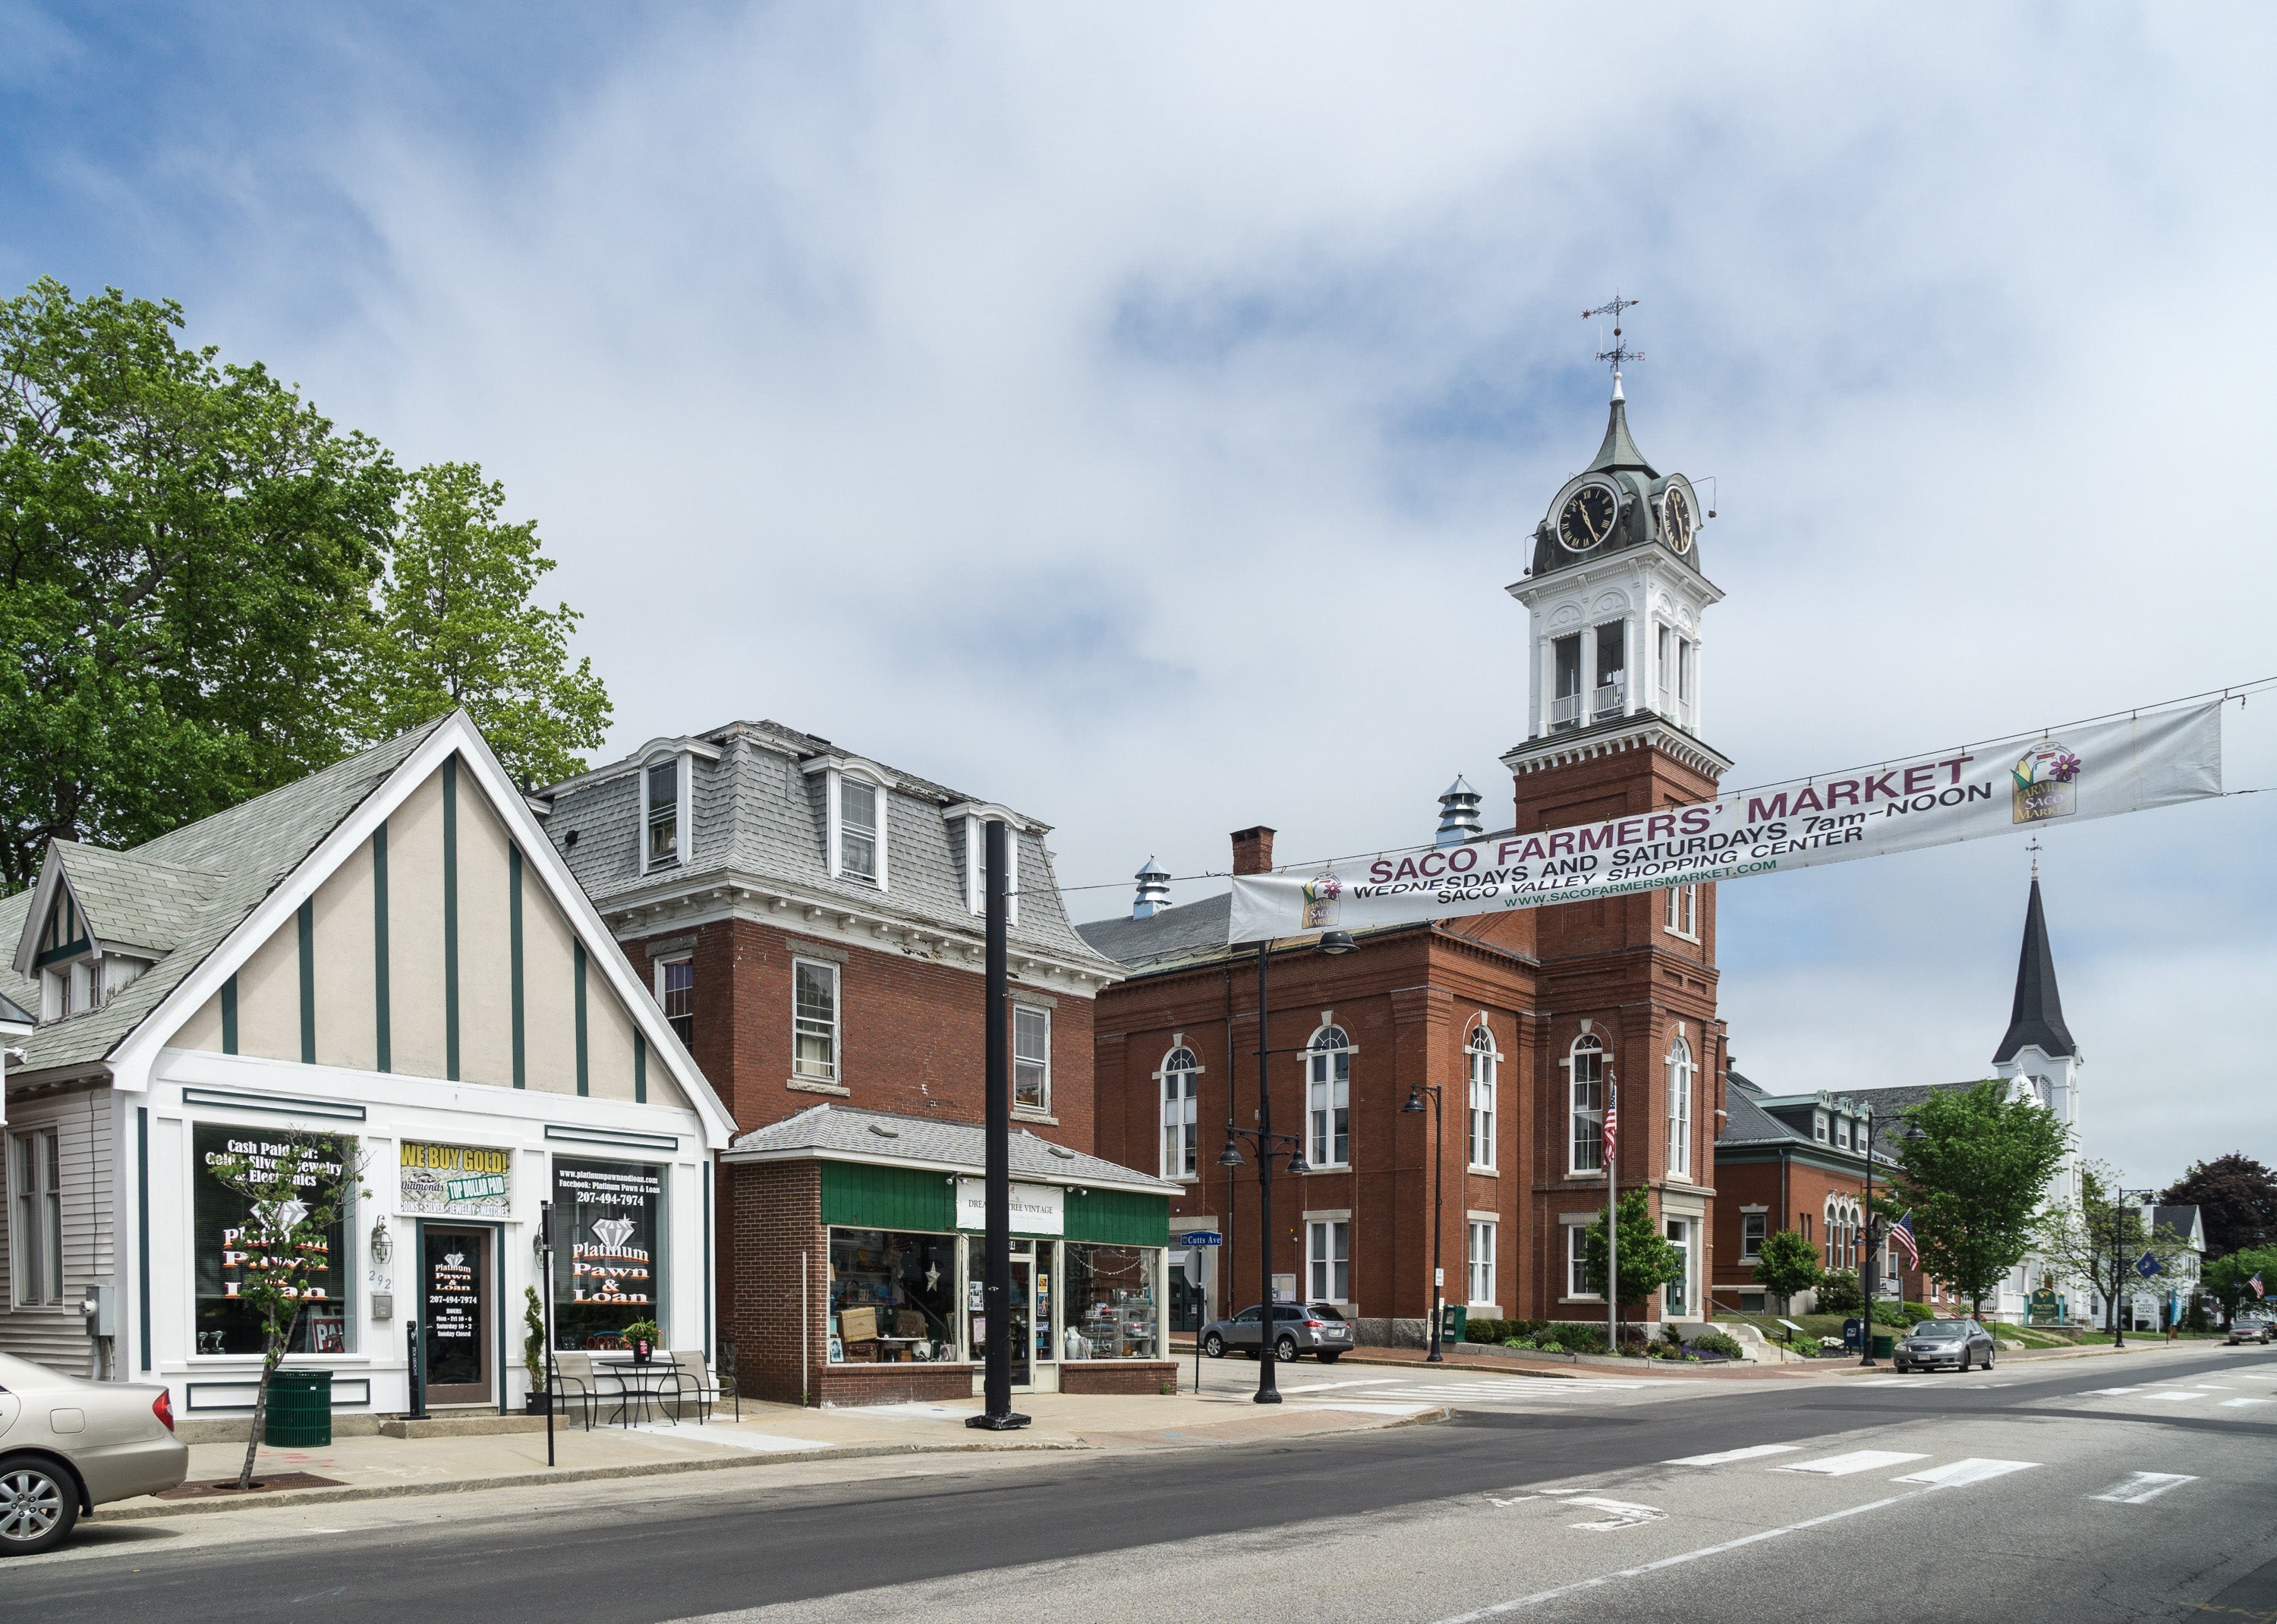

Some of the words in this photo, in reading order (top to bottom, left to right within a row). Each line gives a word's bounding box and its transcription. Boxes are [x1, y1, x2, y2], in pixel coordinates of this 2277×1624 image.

[1583, 537, 1589, 546] VI
[2025, 794, 2063, 809] SACO
[2017, 801, 2071, 820] MARKET
[1369, 848, 1478, 884] SACO
[1498, 804, 1723, 865] FARMERS'
[1748, 756, 1974, 823] MARKET
[1353, 866, 1529, 899] WEDNESDAYS
[1541, 854, 1598, 878] AND
[1612, 822, 1787, 867] SATURDAYS
[1437, 886, 1499, 905] SACO
[1511, 873, 1597, 894] VALLEY
[1607, 850, 1738, 882] SHOPPING
[1750, 826, 1863, 858] CENTER
[1504, 860, 1777, 907] WWW.SACOFARMERSMARKET.COM
[1310, 908, 1331, 918] SACO
[228, 1140, 257, 1153] Cash
[261, 1143, 290, 1157] Paid
[249, 1155, 281, 1169] Silve
[401, 1144, 425, 1167] WE
[428, 1146, 460, 1170] BUY
[463, 1149, 508, 1174] GOLD!
[559, 1170, 658, 1184] www.platinumpawnandloan.com
[401, 1181, 444, 1191] Diamonds
[449, 1181, 463, 1199] TOP
[463, 1178, 488, 1198] DOLLAR
[487, 1176, 504, 1194] PAID
[559, 1179, 591, 1188] Facebook:
[592, 1181, 619, 1191] Platinum
[621, 1184, 638, 1192] Pawn
[577, 1191, 644, 1207] 207-494-7974
[424, 1202, 445, 1214] SILVER
[449, 1203, 476, 1216] JEWELRY
[480, 1205, 509, 1217] WATCHES
[1025, 1204, 1053, 1214] VINTAGE
[1188, 1236, 1205, 1245] Cutts
[1208, 1235, 1220, 1244] Ave
[572, 1242, 649, 1264] Platinum
[572, 1263, 650, 1279] Pawn
[369, 1270, 392, 1289] 292
[602, 1279, 619, 1293] &
[430, 1295, 477, 1304] 207-494-7974
[574, 1289, 649, 1305] Loan
